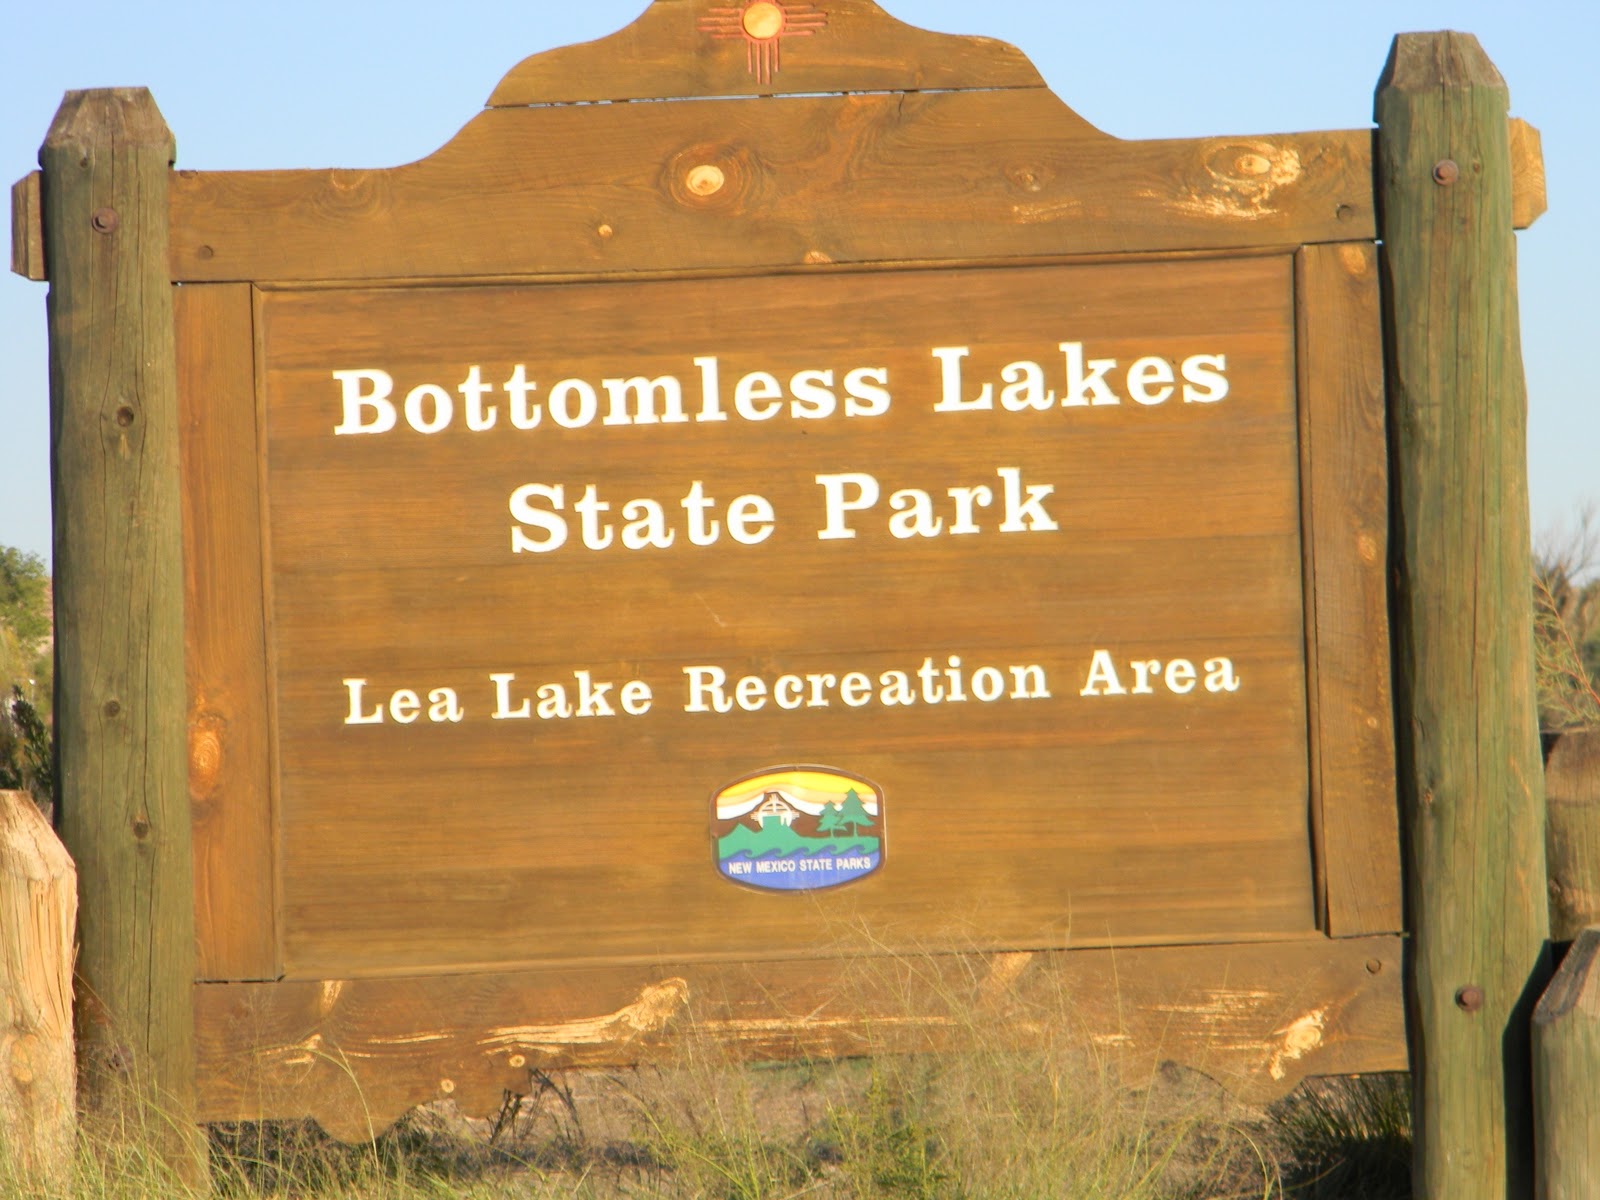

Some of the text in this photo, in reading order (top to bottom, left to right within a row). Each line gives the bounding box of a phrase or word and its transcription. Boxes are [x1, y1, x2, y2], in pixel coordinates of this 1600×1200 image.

[332, 342, 1230, 436] Bottomless Lakes
[508, 467, 1059, 554] State Park
[343, 650, 1241, 725] Lea Lake Recreation Area
[728, 857, 871, 874] NEW MEXICO STATE PARKS
